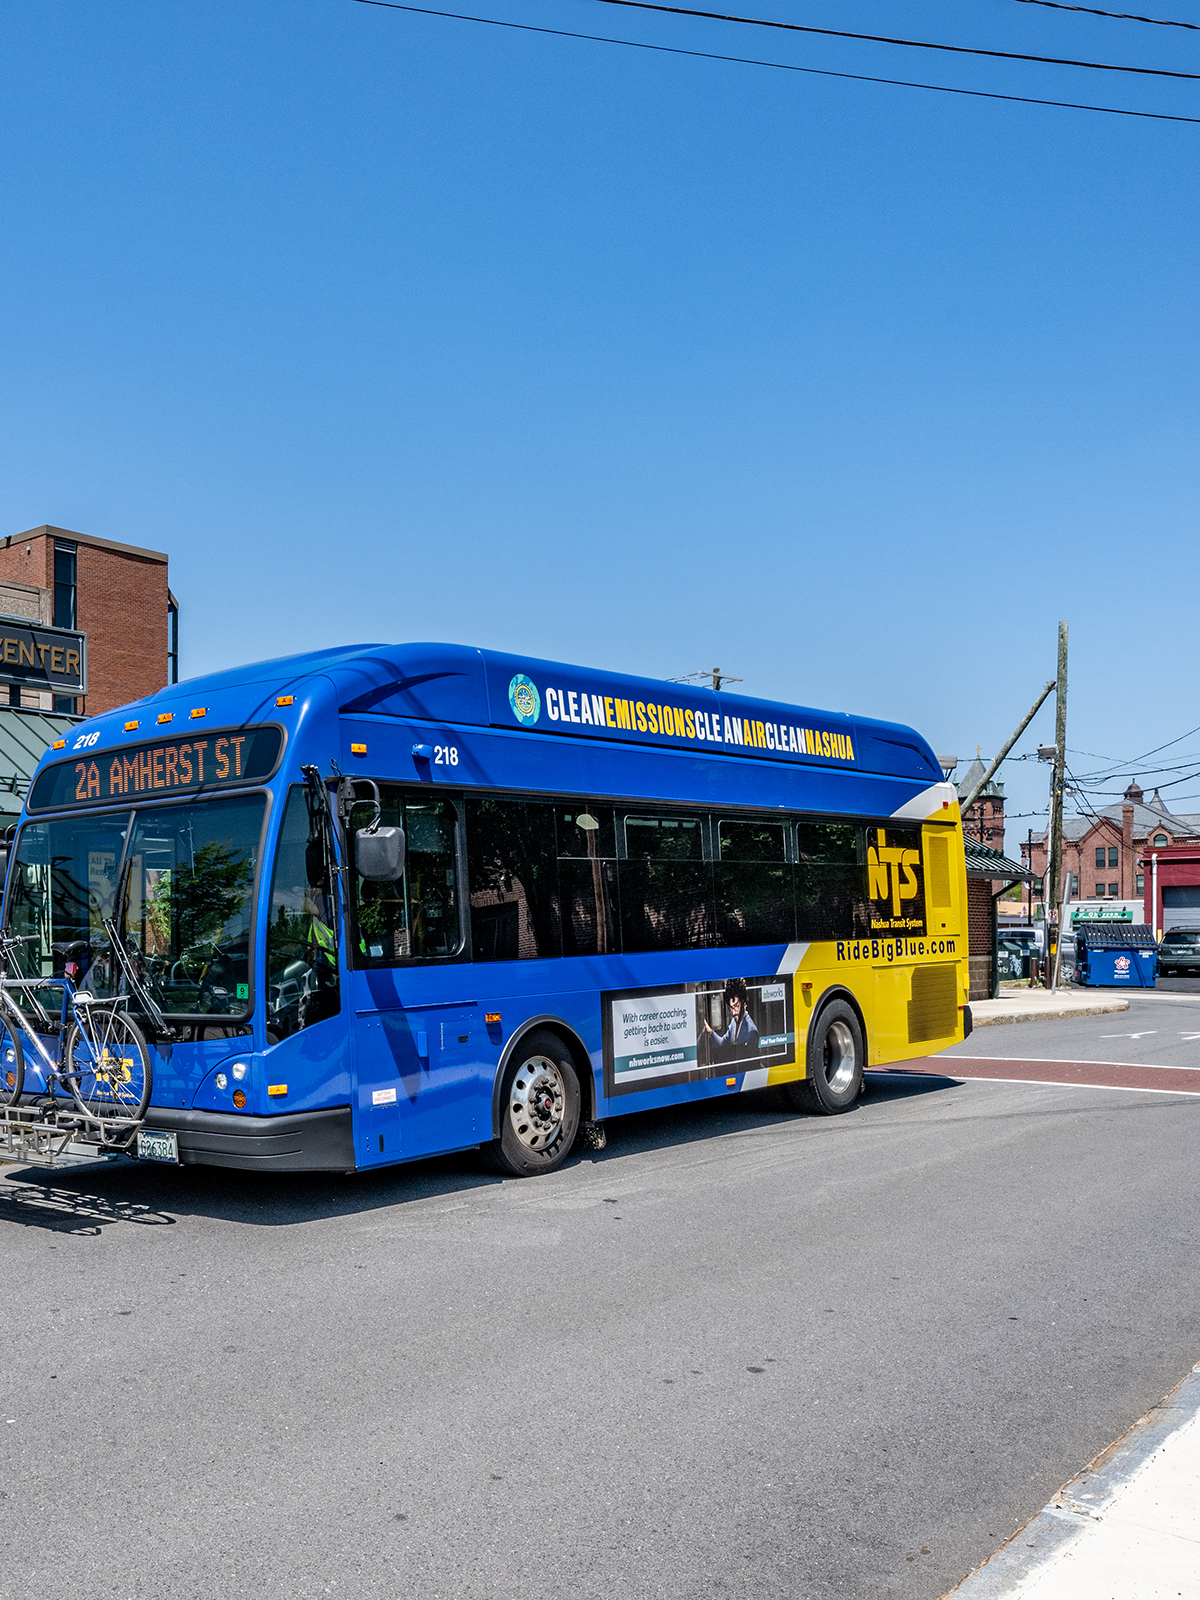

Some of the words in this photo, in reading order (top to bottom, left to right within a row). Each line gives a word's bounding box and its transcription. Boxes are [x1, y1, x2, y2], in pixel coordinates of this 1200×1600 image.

[73, 731, 101, 750] 218
[434, 745, 459, 766] 218
[75, 760, 101, 800] 2A
[109, 740, 208, 795] AMHERST
[215, 736, 246, 779] ST
[867, 828, 920, 917] NTS
[871, 918, 890, 929] Nashua
[890, 917, 906, 928] Transit
[906, 917, 923, 930] System
[836, 938, 956, 962] RideBigBlue.com
[240, 987, 245, 995] 9
[622, 1013, 638, 1023] With
[639, 1012, 659, 1022] career
[659, 1008, 687, 1019] coaching,
[624, 1025, 647, 1039] getting
[648, 1022, 663, 1033] back
[663, 1022, 671, 1031] to
[671, 1019, 688, 1030] work
[643, 1037, 650, 1047] is
[650, 1035, 669, 1046] easier.
[628, 1052, 685, 1068] nhworksnow.com
